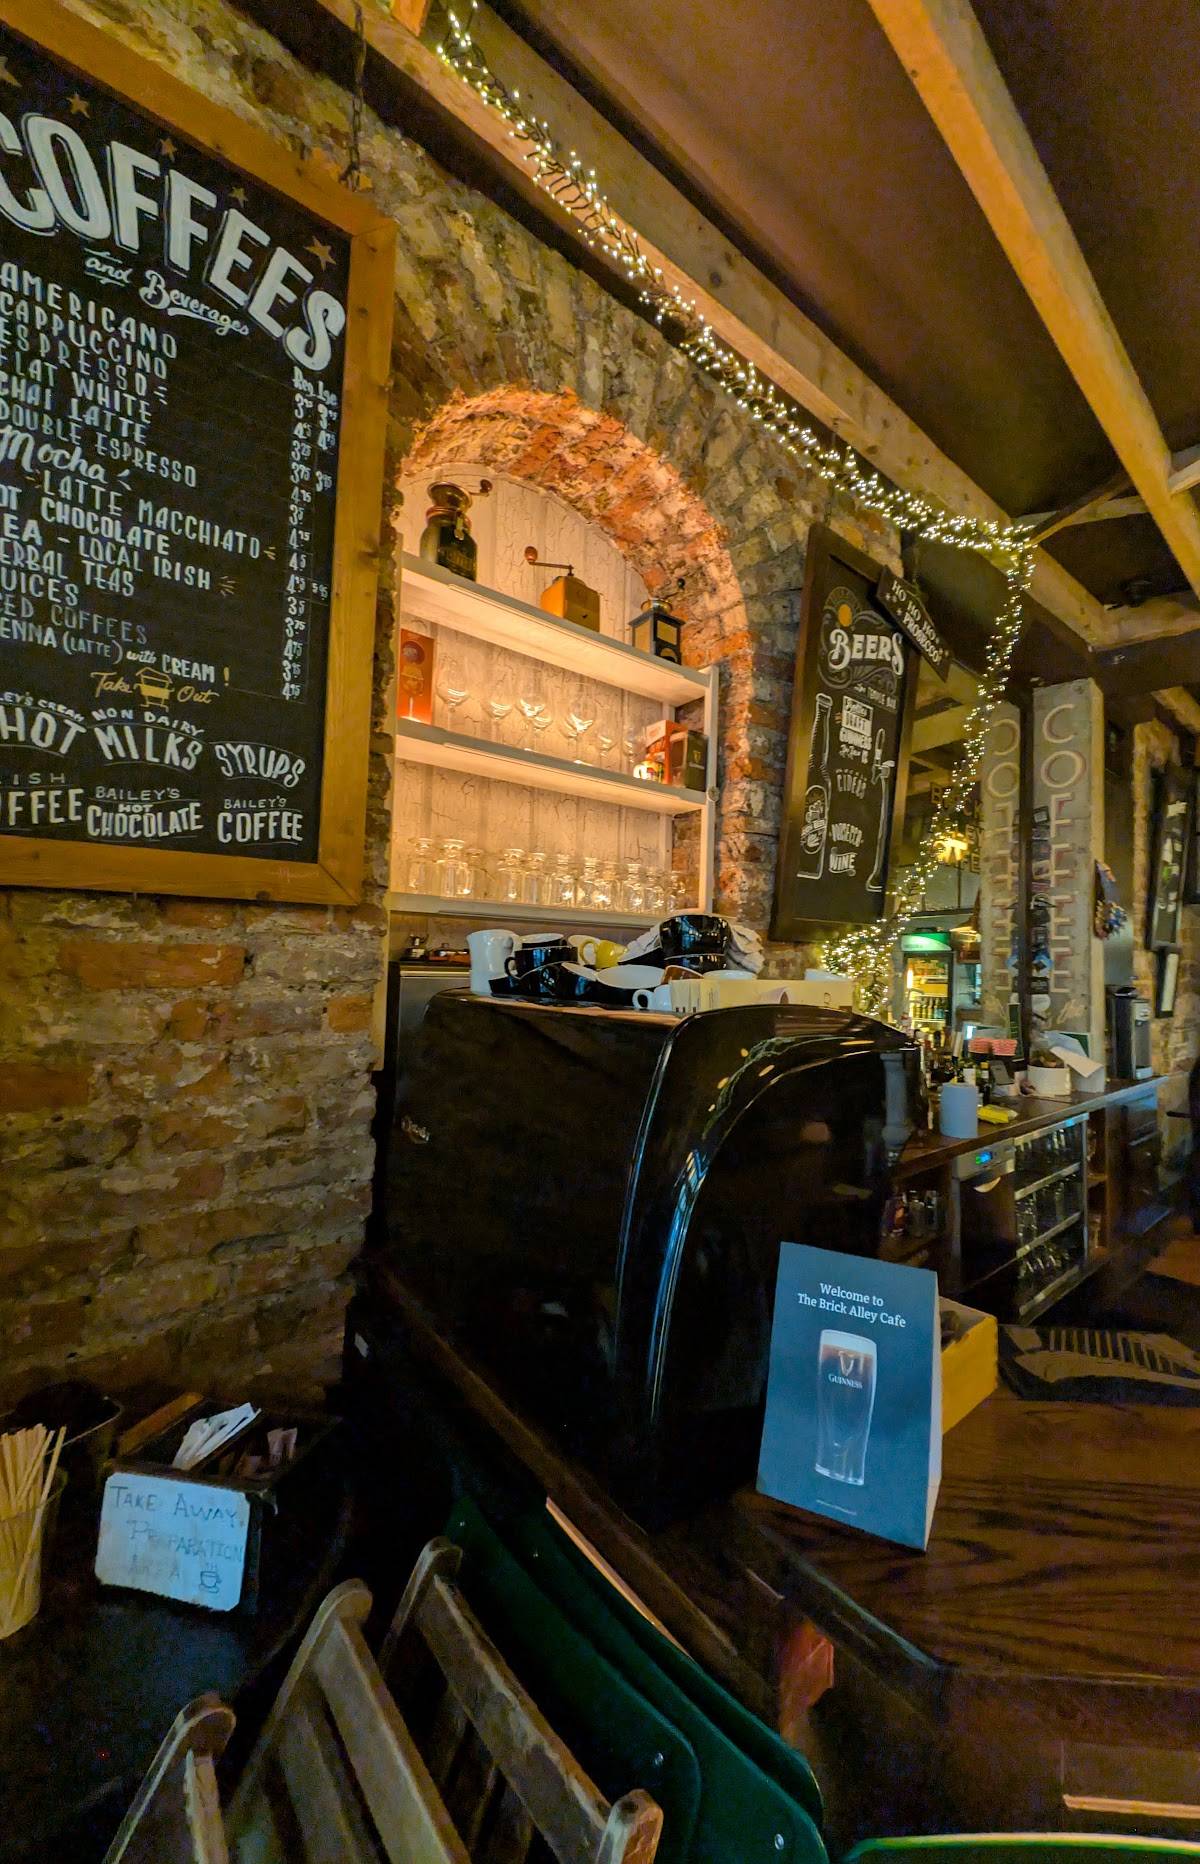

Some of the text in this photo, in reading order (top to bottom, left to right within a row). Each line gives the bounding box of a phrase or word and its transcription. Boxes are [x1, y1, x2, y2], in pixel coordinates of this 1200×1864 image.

[0, 262, 177, 358] AMERICANO
[85, 257, 249, 337] and Beverages
[0, 291, 167, 380] CAPPUCCINO
[0, 317, 148, 397] ESPRESSO
[0, 370, 147, 446] CHAI LATTE
[72, 371, 151, 425] WHITE
[95, 431, 197, 488] ESPRESSO
[41, 497, 171, 555] CHOCOLATE
[44, 470, 260, 559] LATTE MACCHIATO
[79, 536, 143, 572] LOCAL
[154, 556, 210, 591] IRISH
[81, 560, 134, 597] TEAS
[0, 593, 148, 646] ED COFFEES
[90, 671, 220, 704] Take Out
[126, 650, 157, 665] with
[162, 654, 216, 684] CREAM
[0, 705, 87, 755] HOT
[92, 707, 205, 737] NON DAIRY
[94, 725, 203, 771] MILKS
[214, 743, 306, 789] SYRUPS
[0, 788, 85, 827] FFEE
[95, 786, 181, 801] BAILEY'S
[118, 803, 153, 813] HOT
[223, 795, 286, 809] BAILEY'S
[87, 802, 204, 839] CHOCOLATE
[217, 811, 304, 844] COFFEE
[1041, 703, 1083, 993] COFFEE
[797, 1292, 906, 1328] The Brick Alley Cafe
[819, 1282, 884, 1307] Welcome to
[828, 1373, 863, 1390] GUINNESS
[110, 1486, 157, 1512] TAKE
